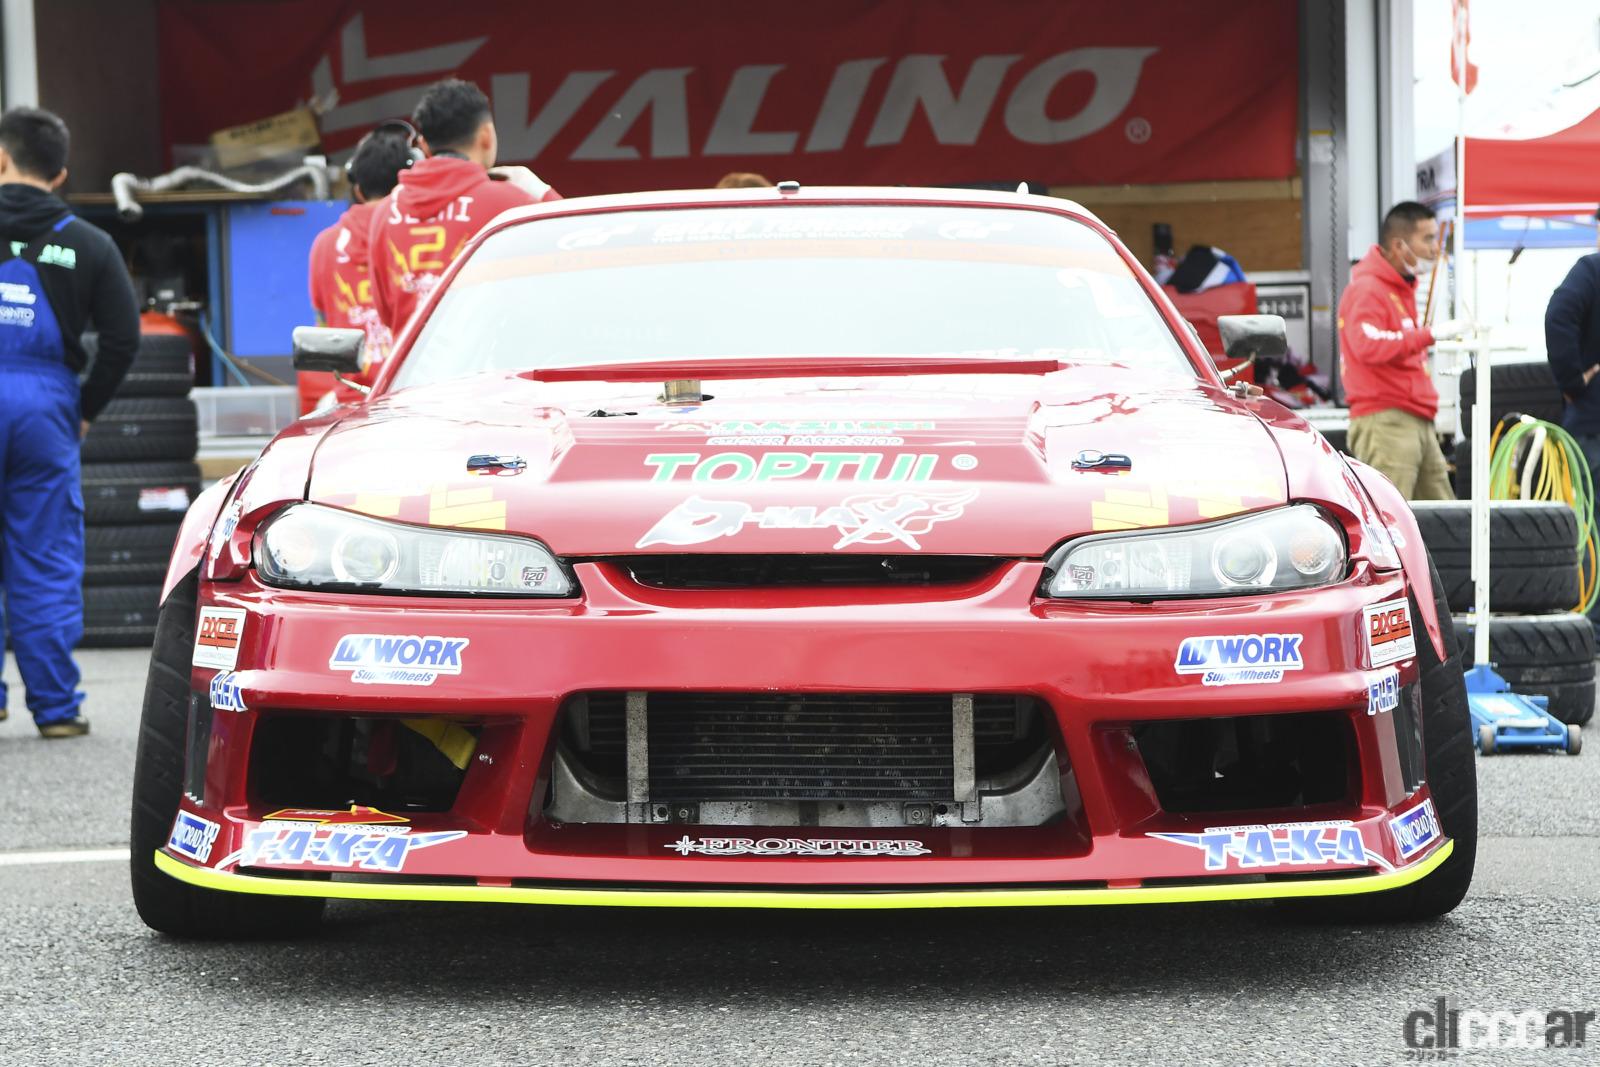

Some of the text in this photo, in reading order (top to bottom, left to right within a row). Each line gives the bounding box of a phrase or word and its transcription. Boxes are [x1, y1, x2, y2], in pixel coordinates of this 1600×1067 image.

[489, 46, 1159, 162] VALINO
[409, 226, 447, 271] 2
[524, 572, 545, 581] 120
[1073, 570, 1093, 580] 120
[1205, 669, 1281, 683] SuprWheels
[699, 837, 930, 854] FRONTIER
